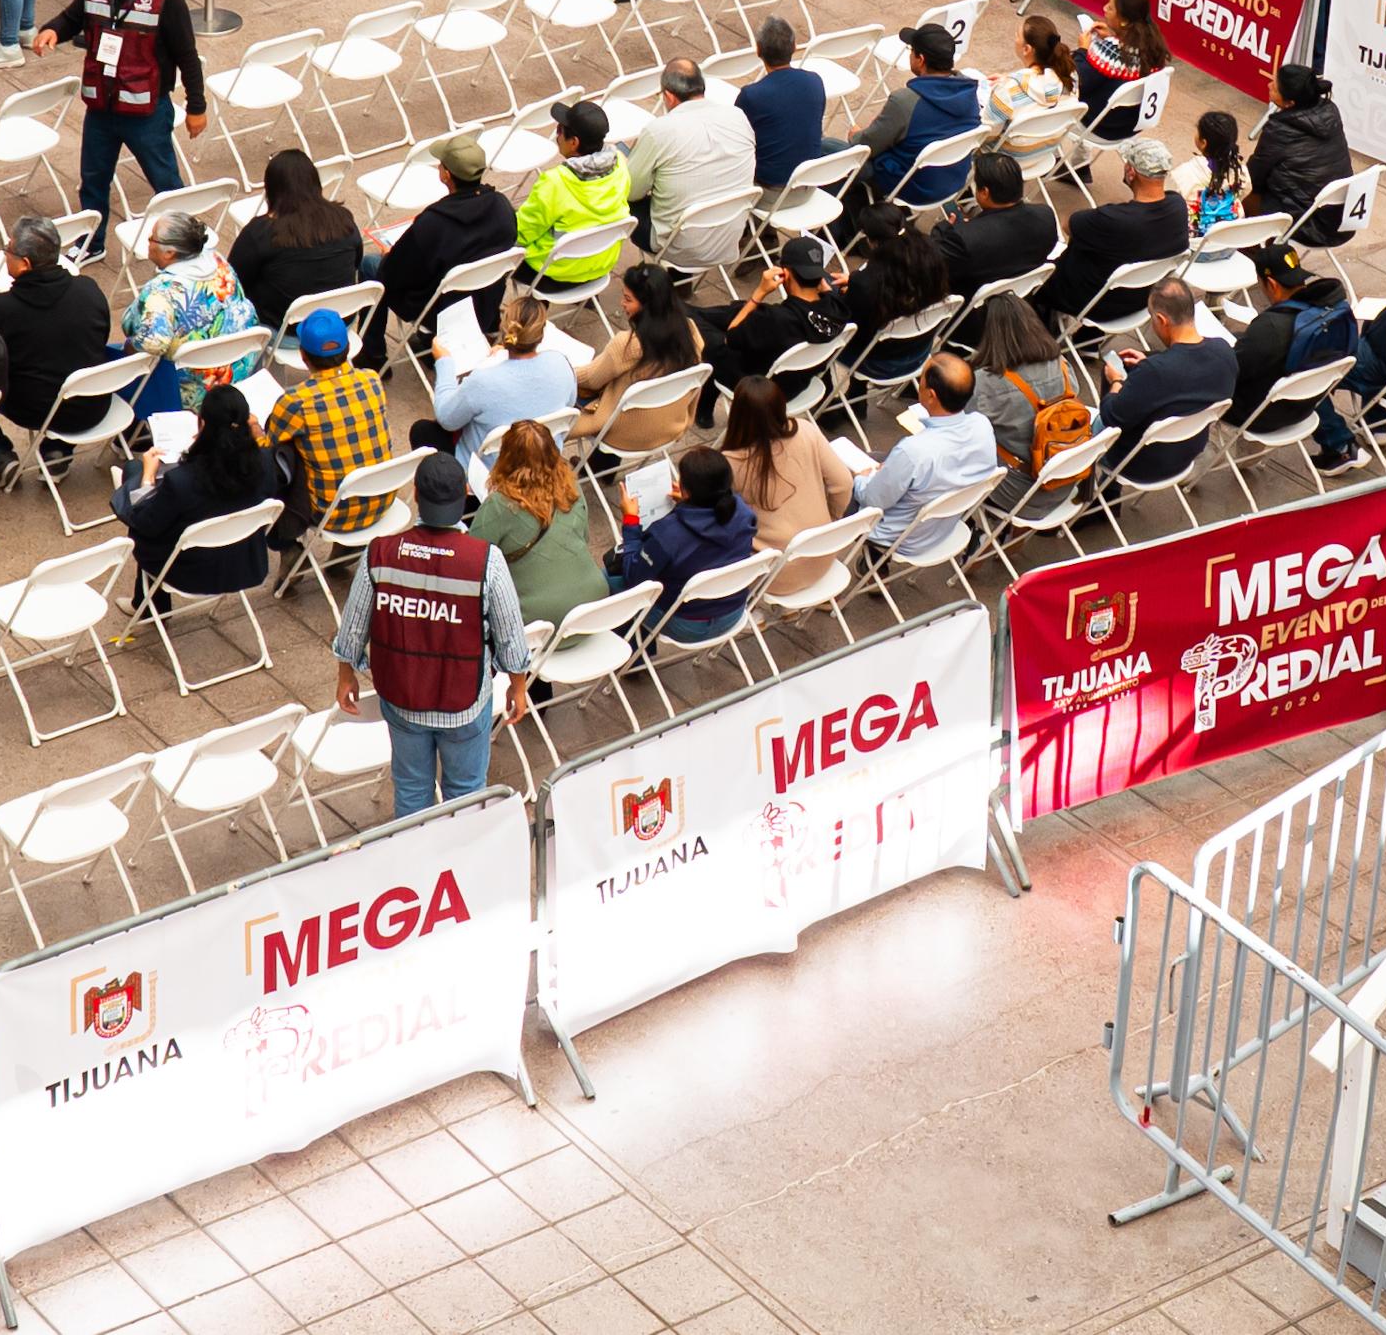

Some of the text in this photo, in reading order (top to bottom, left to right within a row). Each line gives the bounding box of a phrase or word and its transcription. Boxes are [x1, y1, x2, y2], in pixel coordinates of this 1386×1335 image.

[953, 18, 966, 46] 2
[1201, 37, 1234, 61] 2026
[1145, 92, 1158, 119] 3
[1349, 193, 1367, 220] 4
[401, 548, 431, 560] DE TODOS
[402, 542, 455, 556] RESPONSABILIDAD
[377, 592, 462, 624] PREDIAL
[1261, 596, 1369, 653] EVENTO
[1042, 651, 1152, 702] TIJUANA
[1181, 629, 1383, 733] PREDIAL
[1271, 692, 1321, 718] 2026
[771, 680, 939, 794] MEGA
[596, 835, 710, 905] TIJUANA
[263, 869, 470, 995] MEGA
[45, 1037, 183, 1108] TIJUANA
